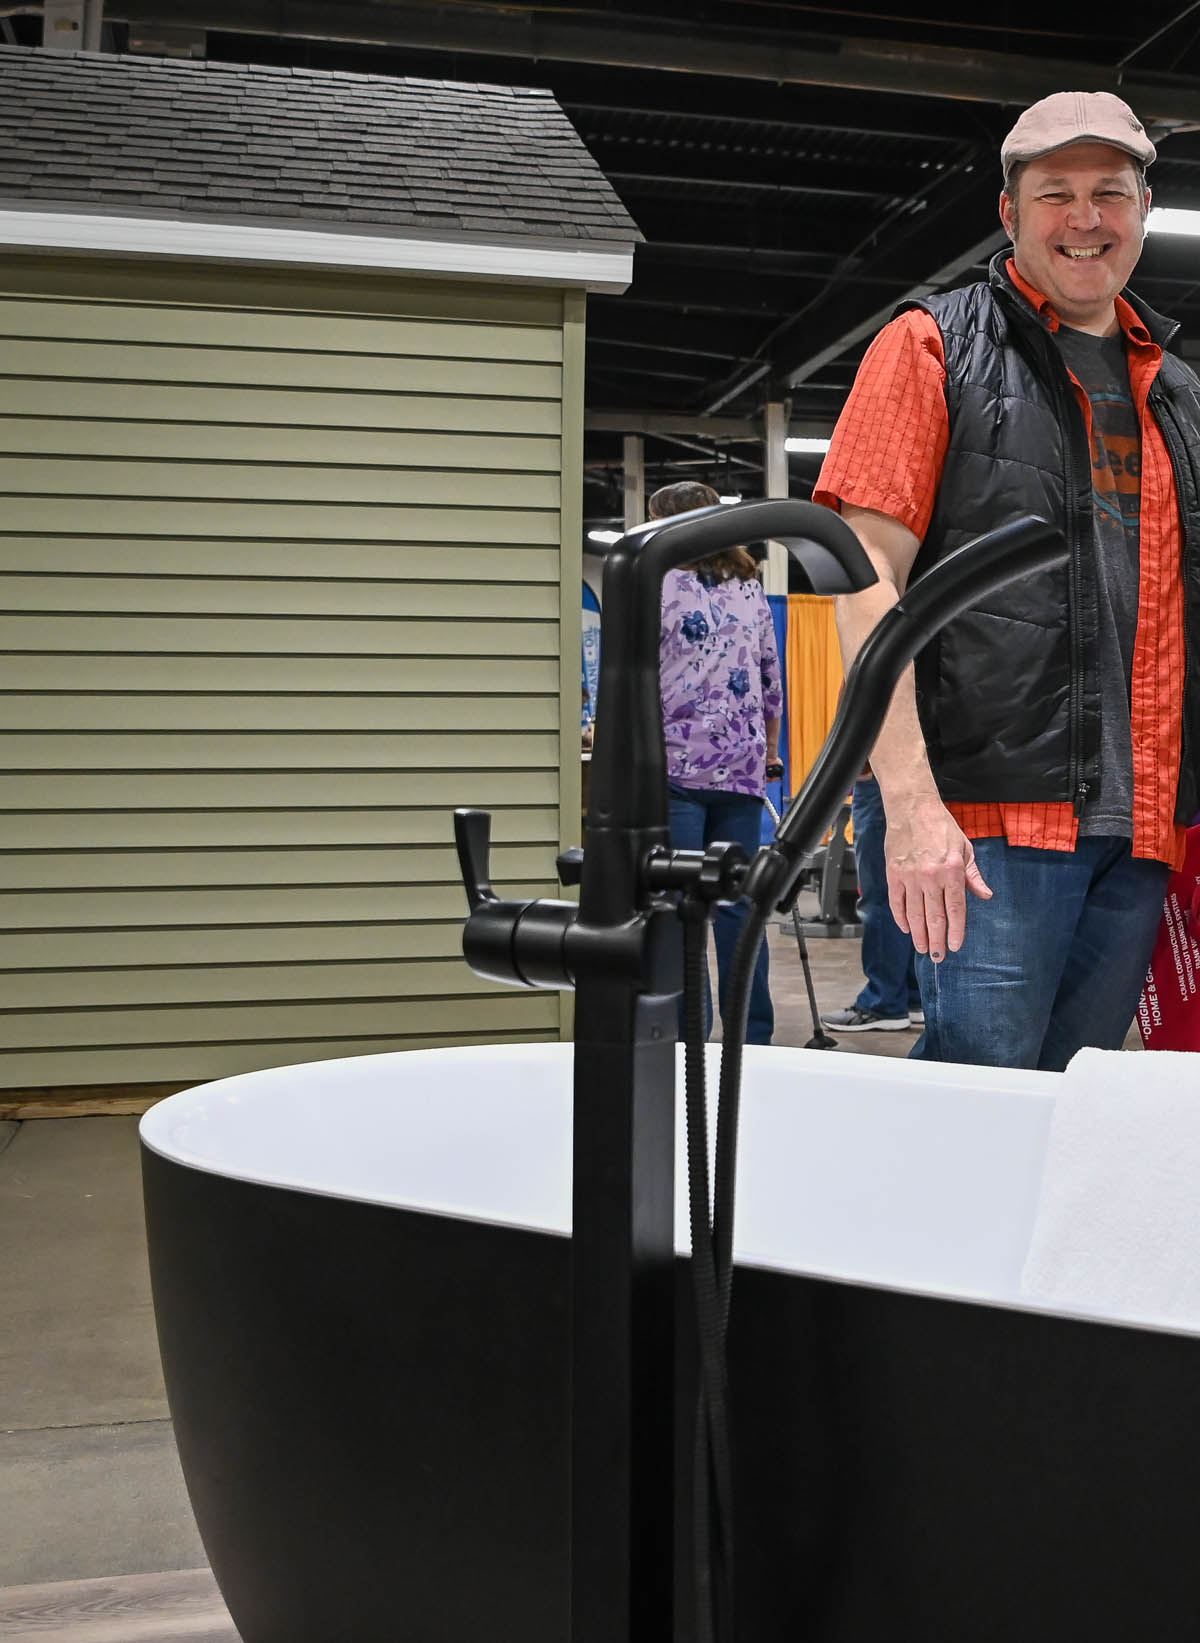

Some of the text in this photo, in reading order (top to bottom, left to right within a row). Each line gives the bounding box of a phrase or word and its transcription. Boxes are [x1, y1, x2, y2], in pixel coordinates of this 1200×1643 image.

[1092, 434, 1141, 477] Jee
[1170, 892, 1182, 921] SYSTEMS
[1168, 925, 1183, 974] CONSTRUCTION
[1176, 920, 1188, 951] BUSINESS
[1148, 983, 1157, 993] &
[1183, 951, 1196, 994] CONNECTICUT
[1149, 993, 1162, 1026] HOME
